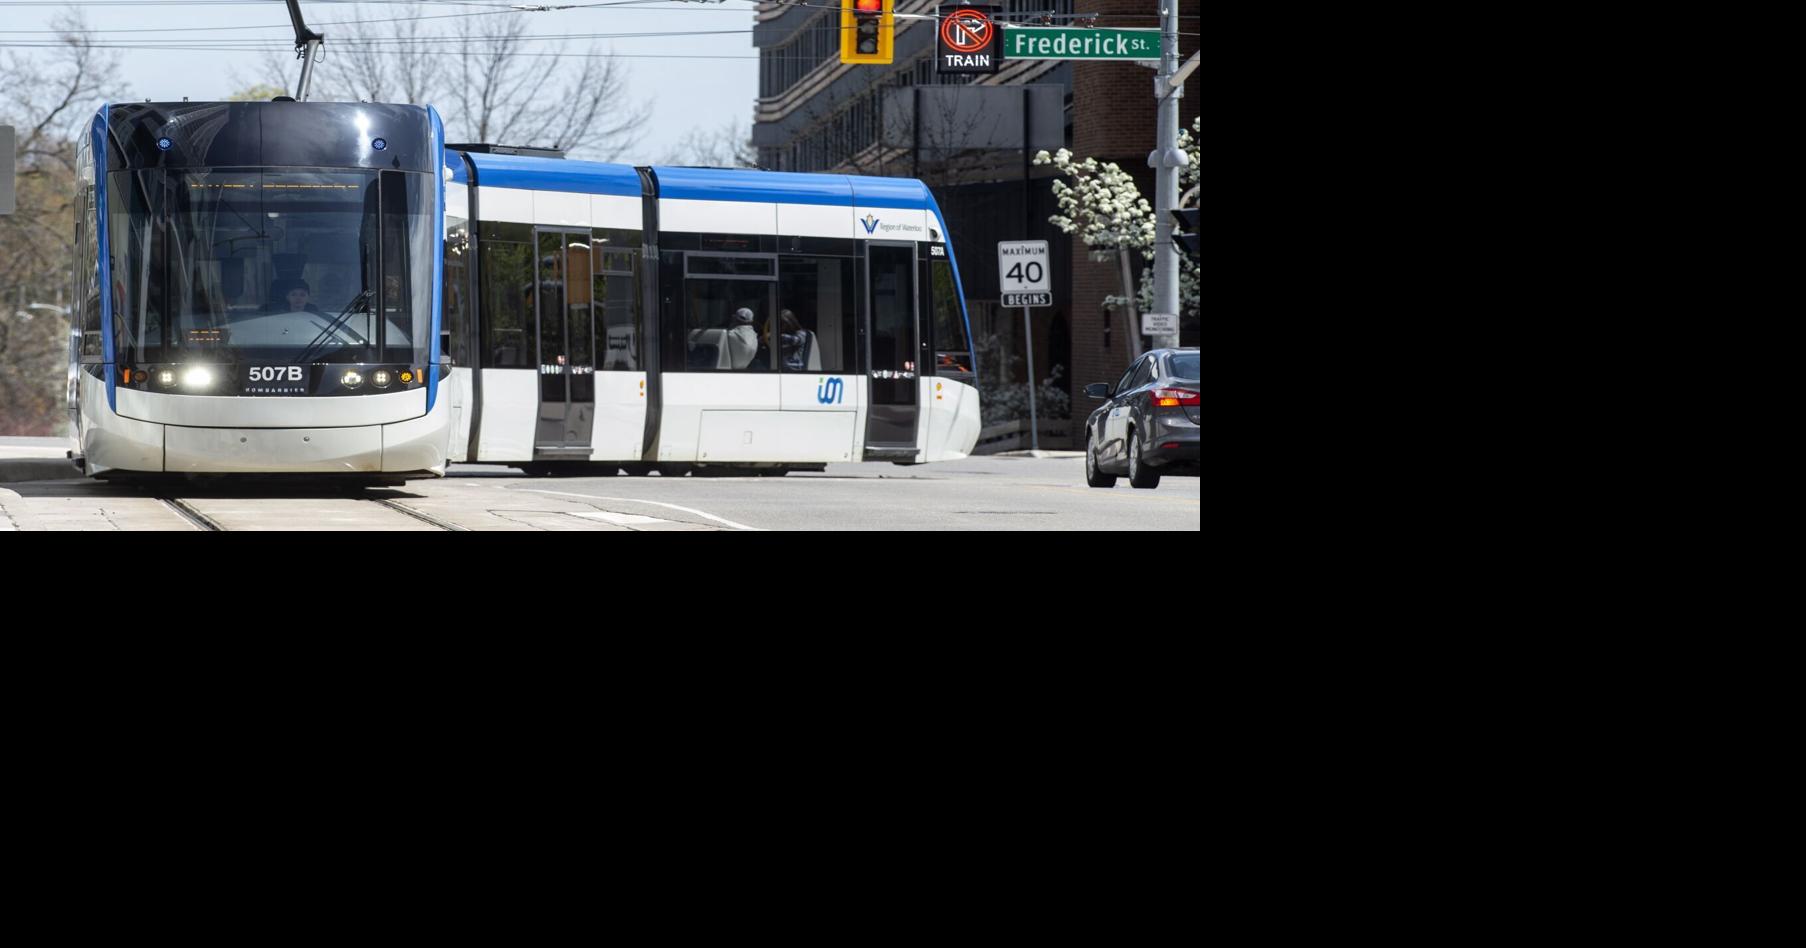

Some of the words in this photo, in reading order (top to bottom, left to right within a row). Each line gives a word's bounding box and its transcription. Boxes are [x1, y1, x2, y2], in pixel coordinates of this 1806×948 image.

[1015, 33, 1129, 54] Frederick
[1131, 38, 1150, 50] St.
[945, 54, 990, 67] TRAIN
[930, 246, 945, 256] 507A
[1002, 247, 1045, 255] MAXIMUM
[1005, 261, 1043, 283] 40
[1008, 294, 1046, 305] BEGINS
[249, 366, 303, 381] 507B
